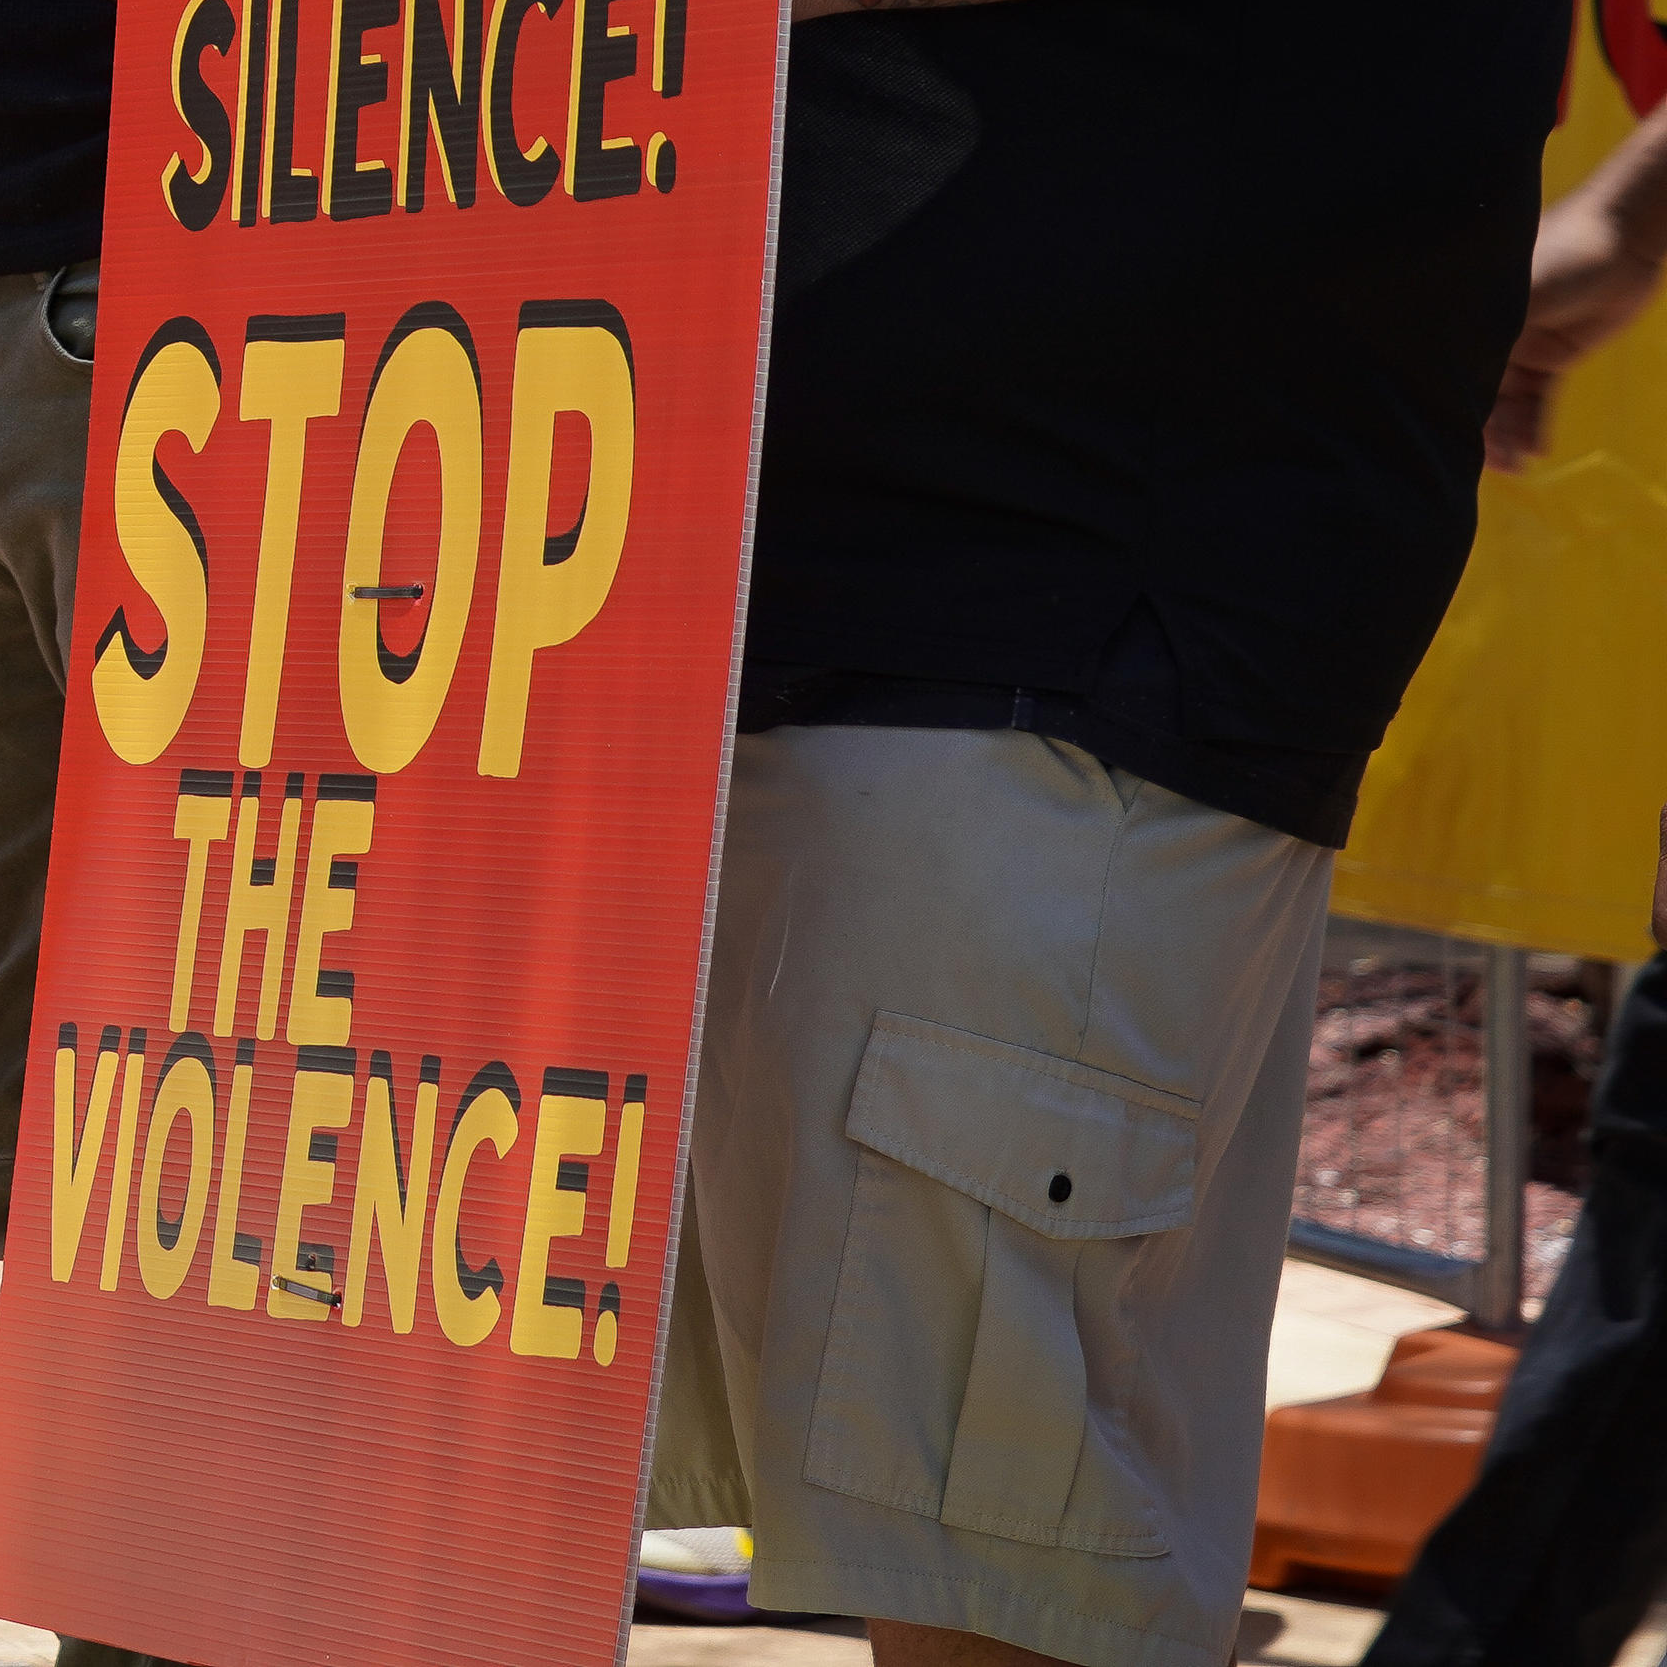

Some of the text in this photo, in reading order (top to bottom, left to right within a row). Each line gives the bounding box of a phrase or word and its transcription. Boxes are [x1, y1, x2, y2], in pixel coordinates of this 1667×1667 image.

[91, 298, 637, 779] STOP
[169, 769, 377, 1046] THE
[50, 1021, 648, 1368] VIOLENCE!
